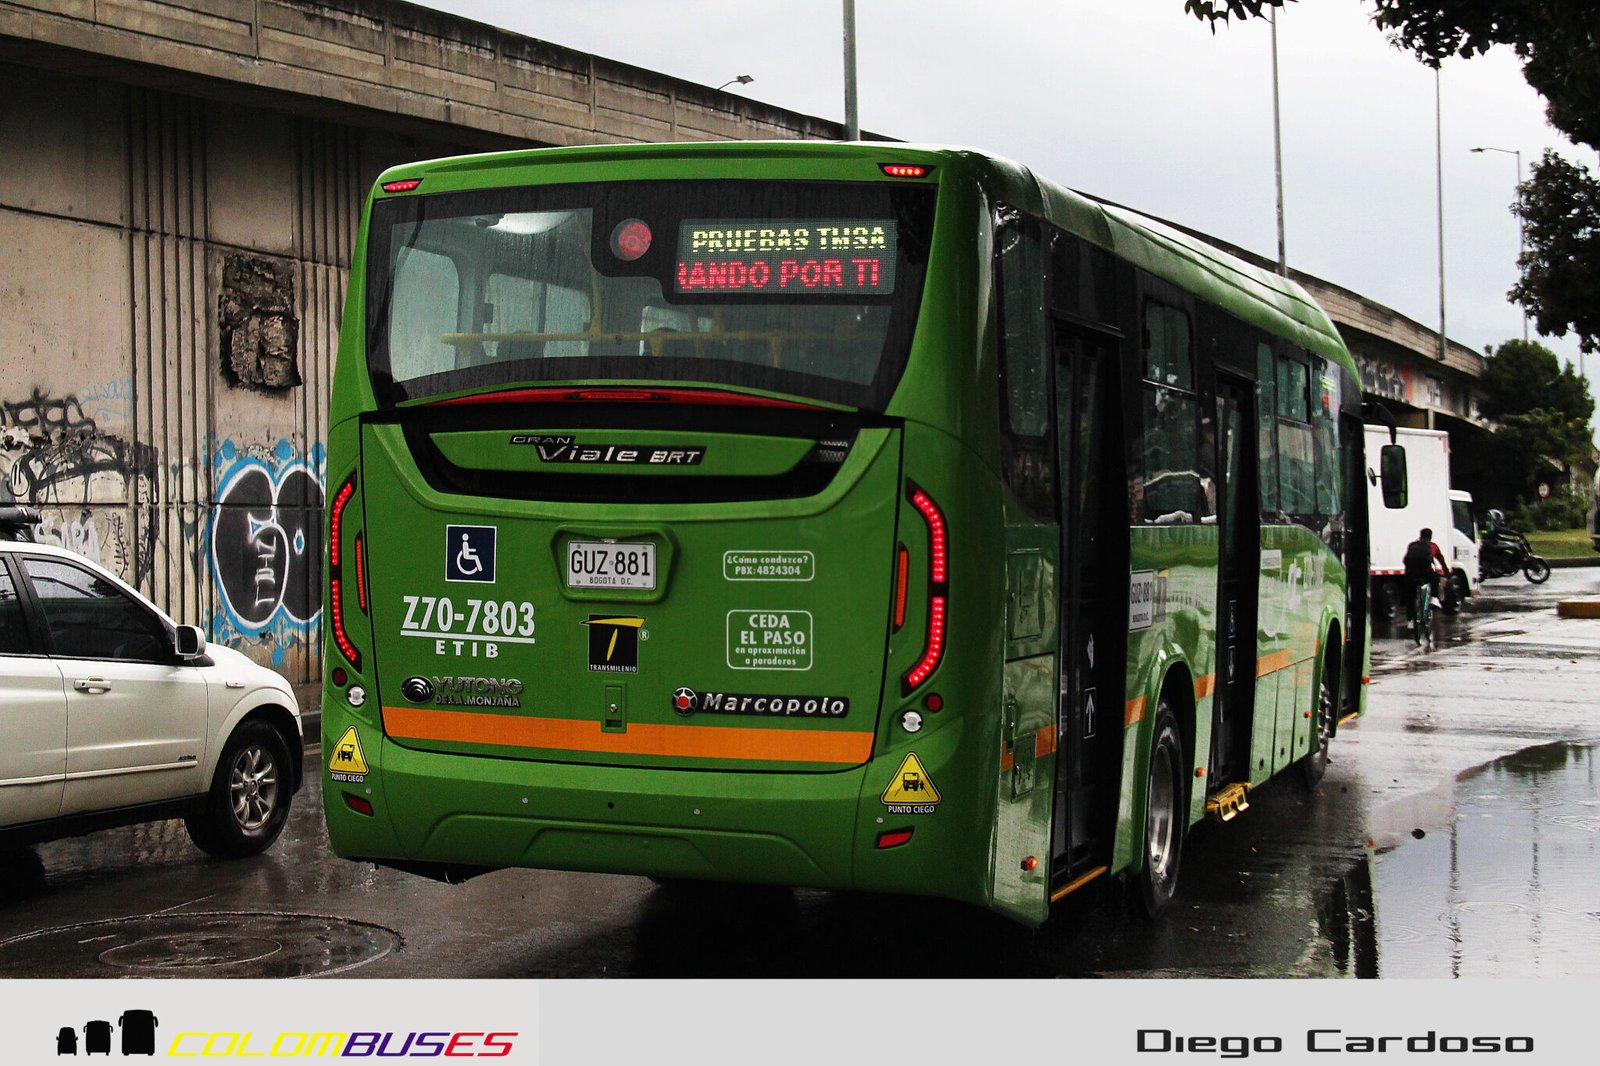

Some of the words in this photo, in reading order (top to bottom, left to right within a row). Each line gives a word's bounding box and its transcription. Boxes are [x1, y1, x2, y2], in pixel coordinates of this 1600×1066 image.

[692, 228, 809, 252] PRUEBAS
[816, 227, 886, 250] TMSA
[779, 259, 844, 288] POR
[851, 258, 880, 287] TI
[512, 436, 570, 444] GRAN
[538, 445, 639, 462] Viale
[649, 450, 701, 463] BRT
[571, 550, 608, 575] GUZ
[614, 551, 651, 576] 881
[760, 555, 809, 565] conduzco?
[735, 565, 801, 575] PBX:4824304
[589, 577, 616, 585] BOGOTA
[402, 595, 536, 637] Z70-7803
[748, 614, 790, 629] CEDA
[740, 630, 757, 645] EL
[763, 630, 806, 646] PASO
[435, 639, 499, 659] ETIB
[735, 647, 746, 655] en
[748, 645, 806, 656] aproximación
[590, 664, 637, 673] TRANSMILENIO
[752, 656, 796, 667] paraderos
[433, 676, 523, 695] YUTONG
[702, 693, 845, 715] Marcopolo
[888, 805, 912, 813] PUNTO
[913, 805, 935, 813] CIEGO
